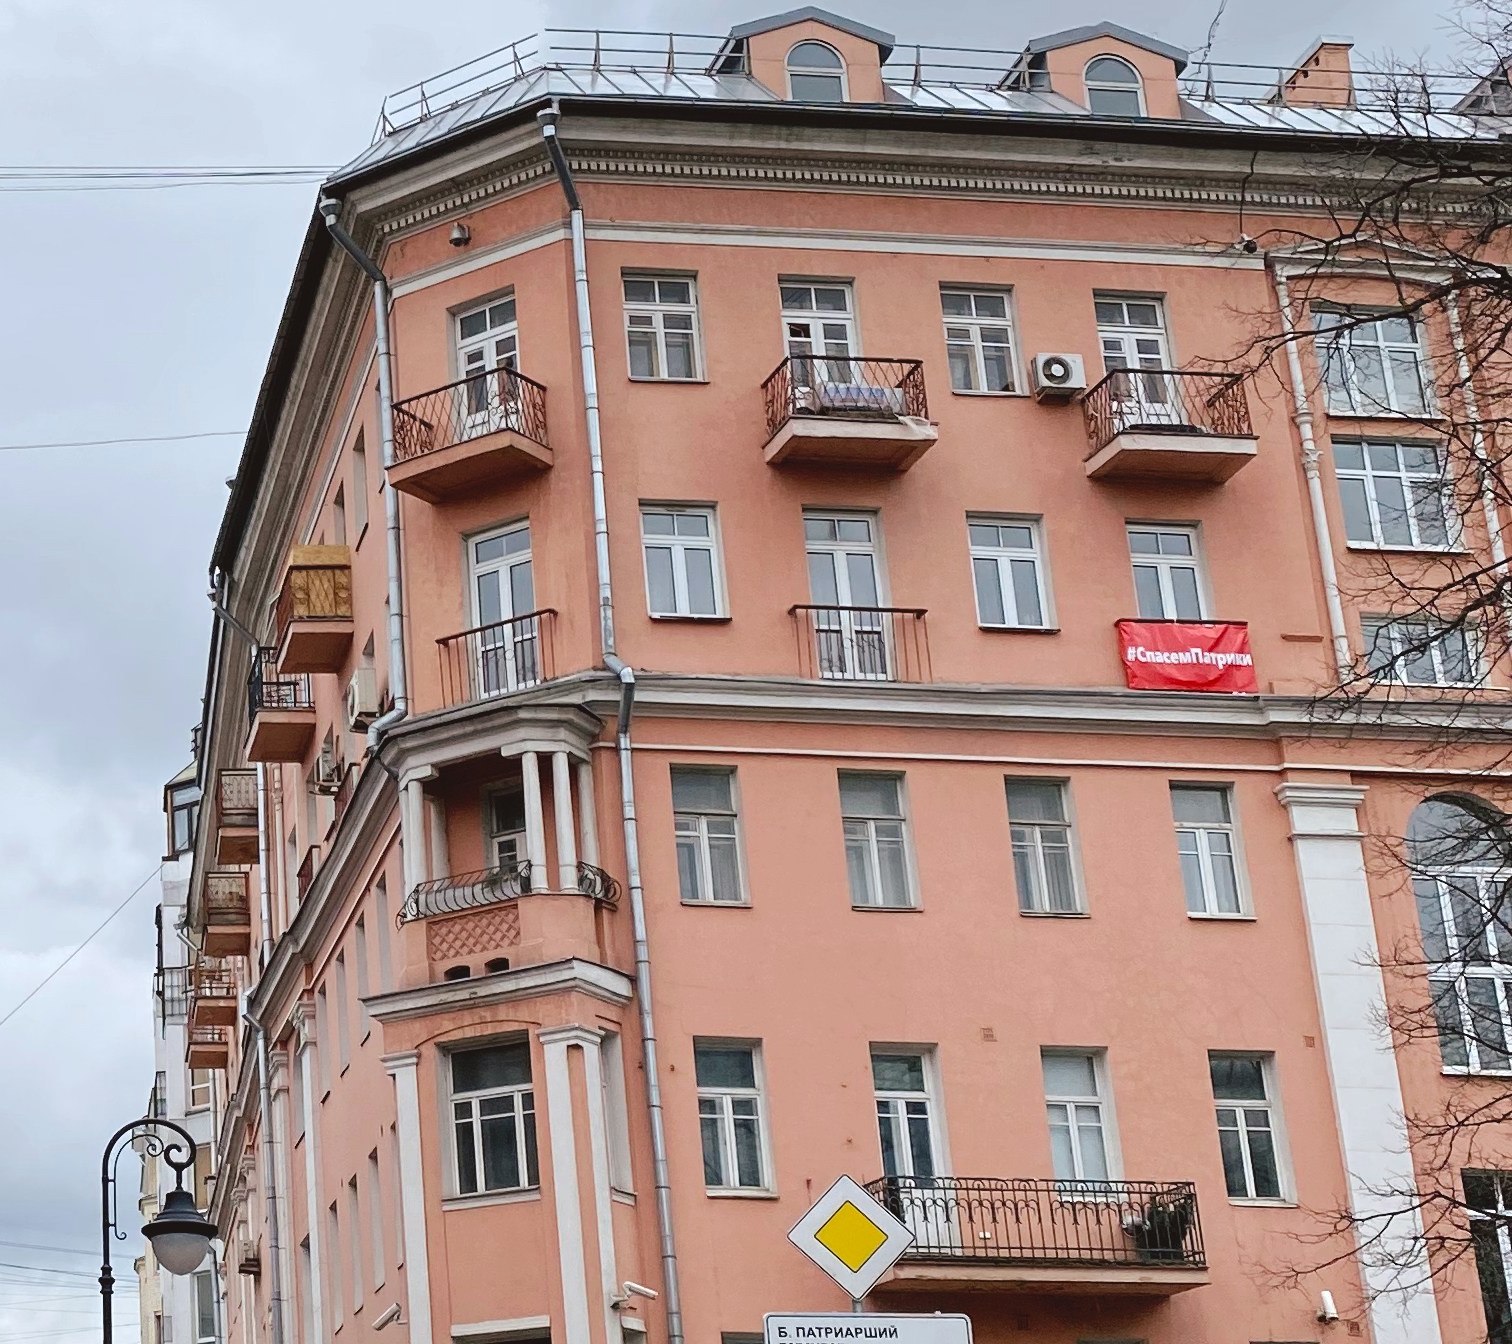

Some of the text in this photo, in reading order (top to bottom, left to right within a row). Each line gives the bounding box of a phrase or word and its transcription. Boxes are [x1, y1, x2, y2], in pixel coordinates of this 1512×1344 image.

[1127, 646, 1253, 670] #СпасемПатрики
[778, 1325, 899, 1339] Б. ПАТРИАРШИЙ
